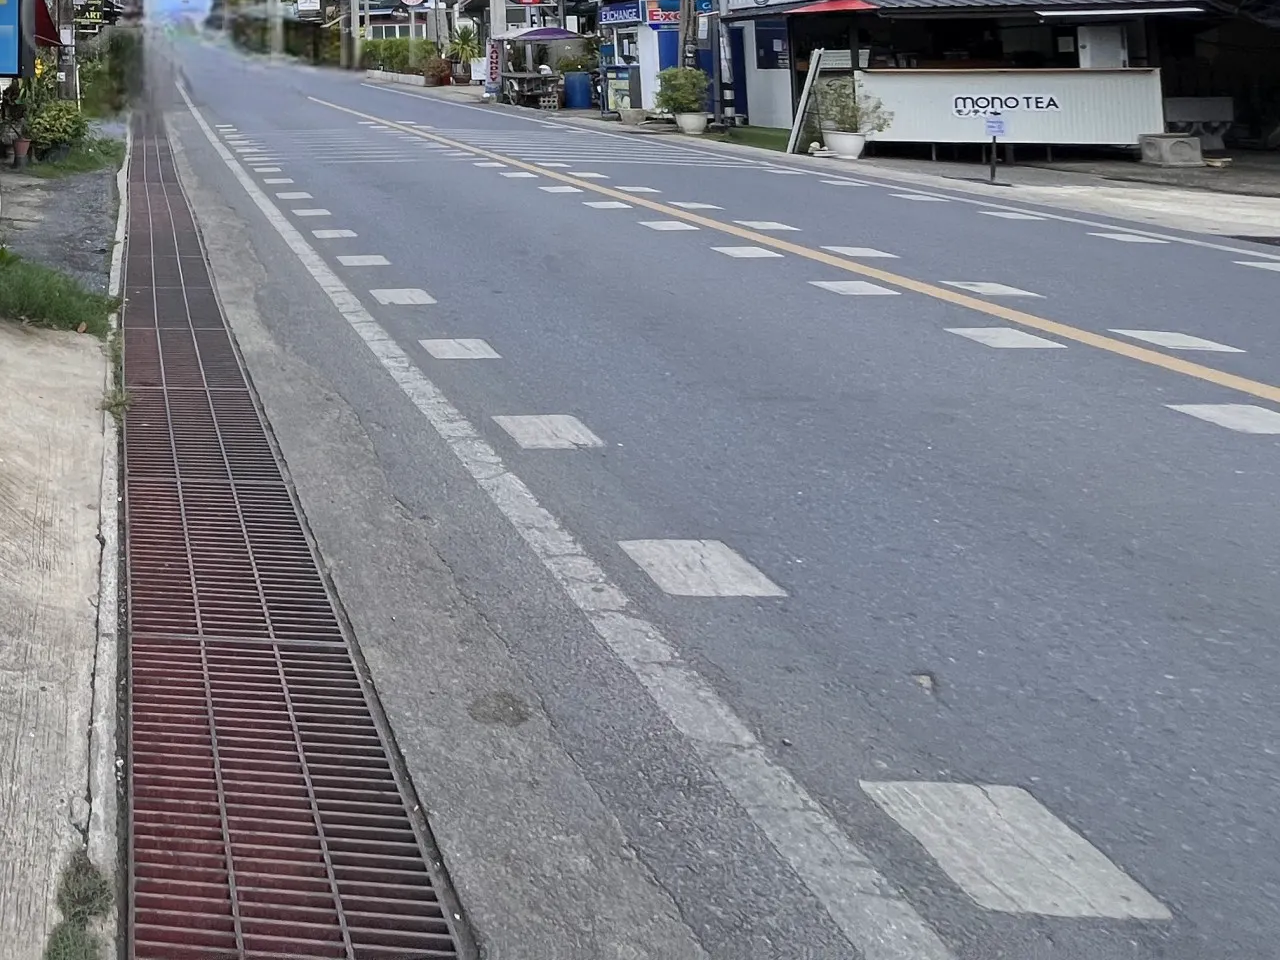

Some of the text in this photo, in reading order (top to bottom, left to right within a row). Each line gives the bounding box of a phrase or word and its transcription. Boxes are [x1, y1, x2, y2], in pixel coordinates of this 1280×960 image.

[601, 8, 637, 22] EXCHANGE
[490, 43, 499, 81] LAUNDRY
[1022, 96, 1059, 109] TEA
